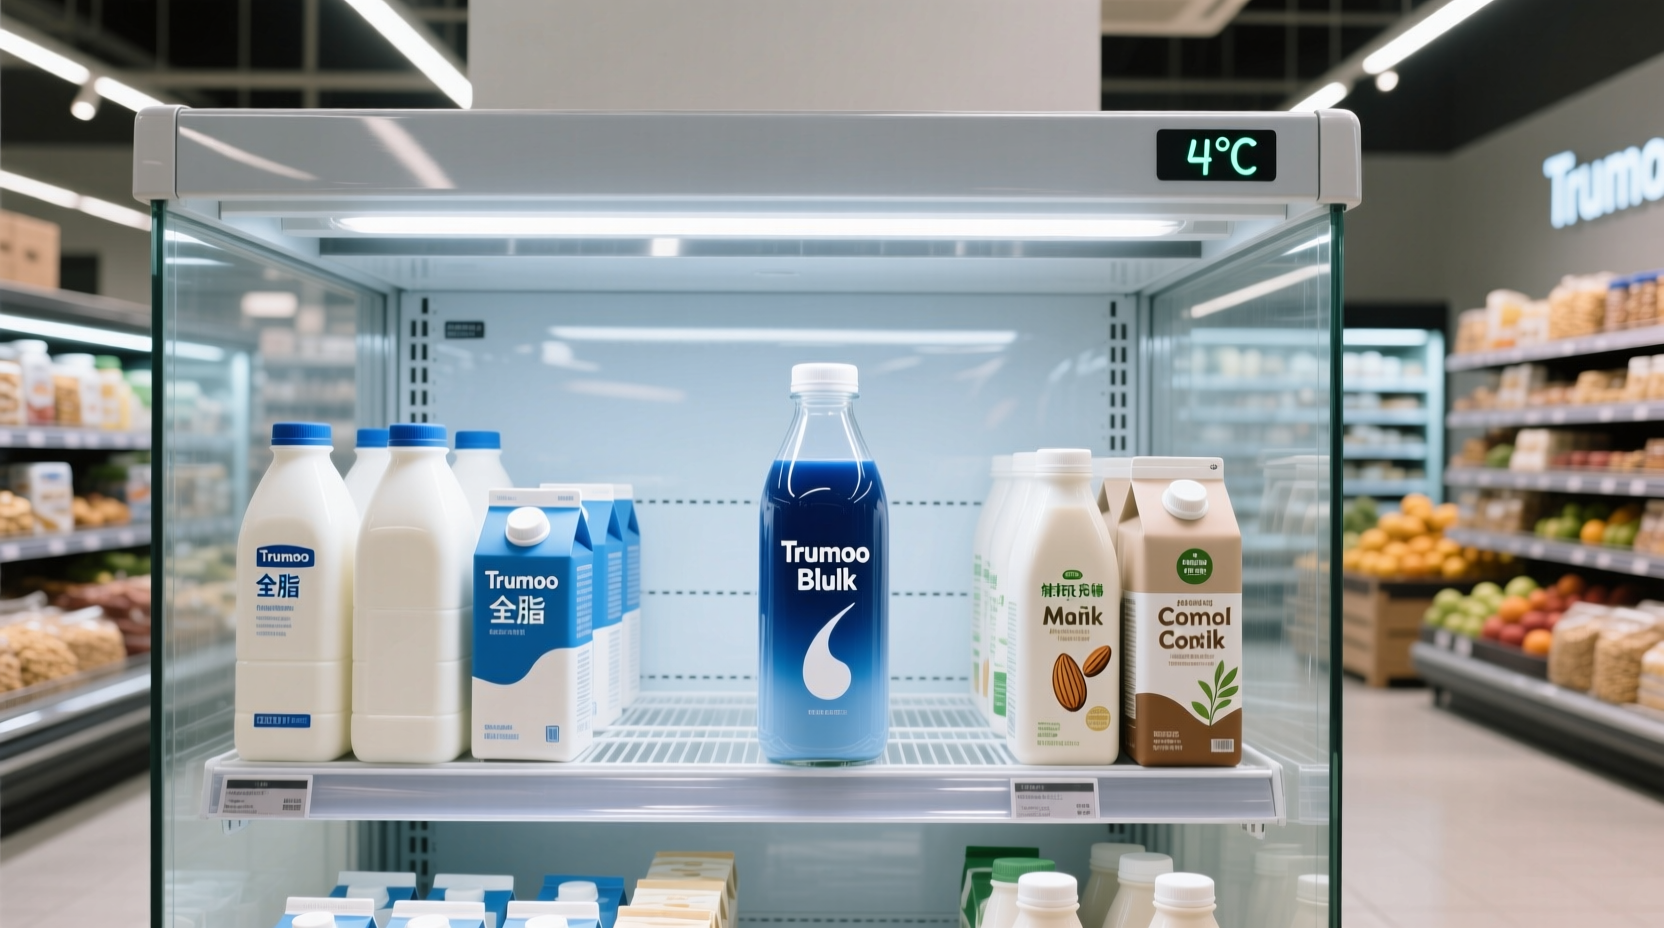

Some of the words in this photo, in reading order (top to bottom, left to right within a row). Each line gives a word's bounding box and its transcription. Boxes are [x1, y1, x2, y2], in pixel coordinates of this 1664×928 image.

[1187, 136, 1258, 177] 4°C
[259, 549, 310, 563] Trumoo
[781, 540, 870, 563] Trumoo
[255, 573, 301, 599] 全脂
[484, 570, 559, 590] Trumoo
[797, 567, 858, 591] Blulk
[488, 595, 546, 626] 全脂
[1158, 606, 1231, 626] Comol
